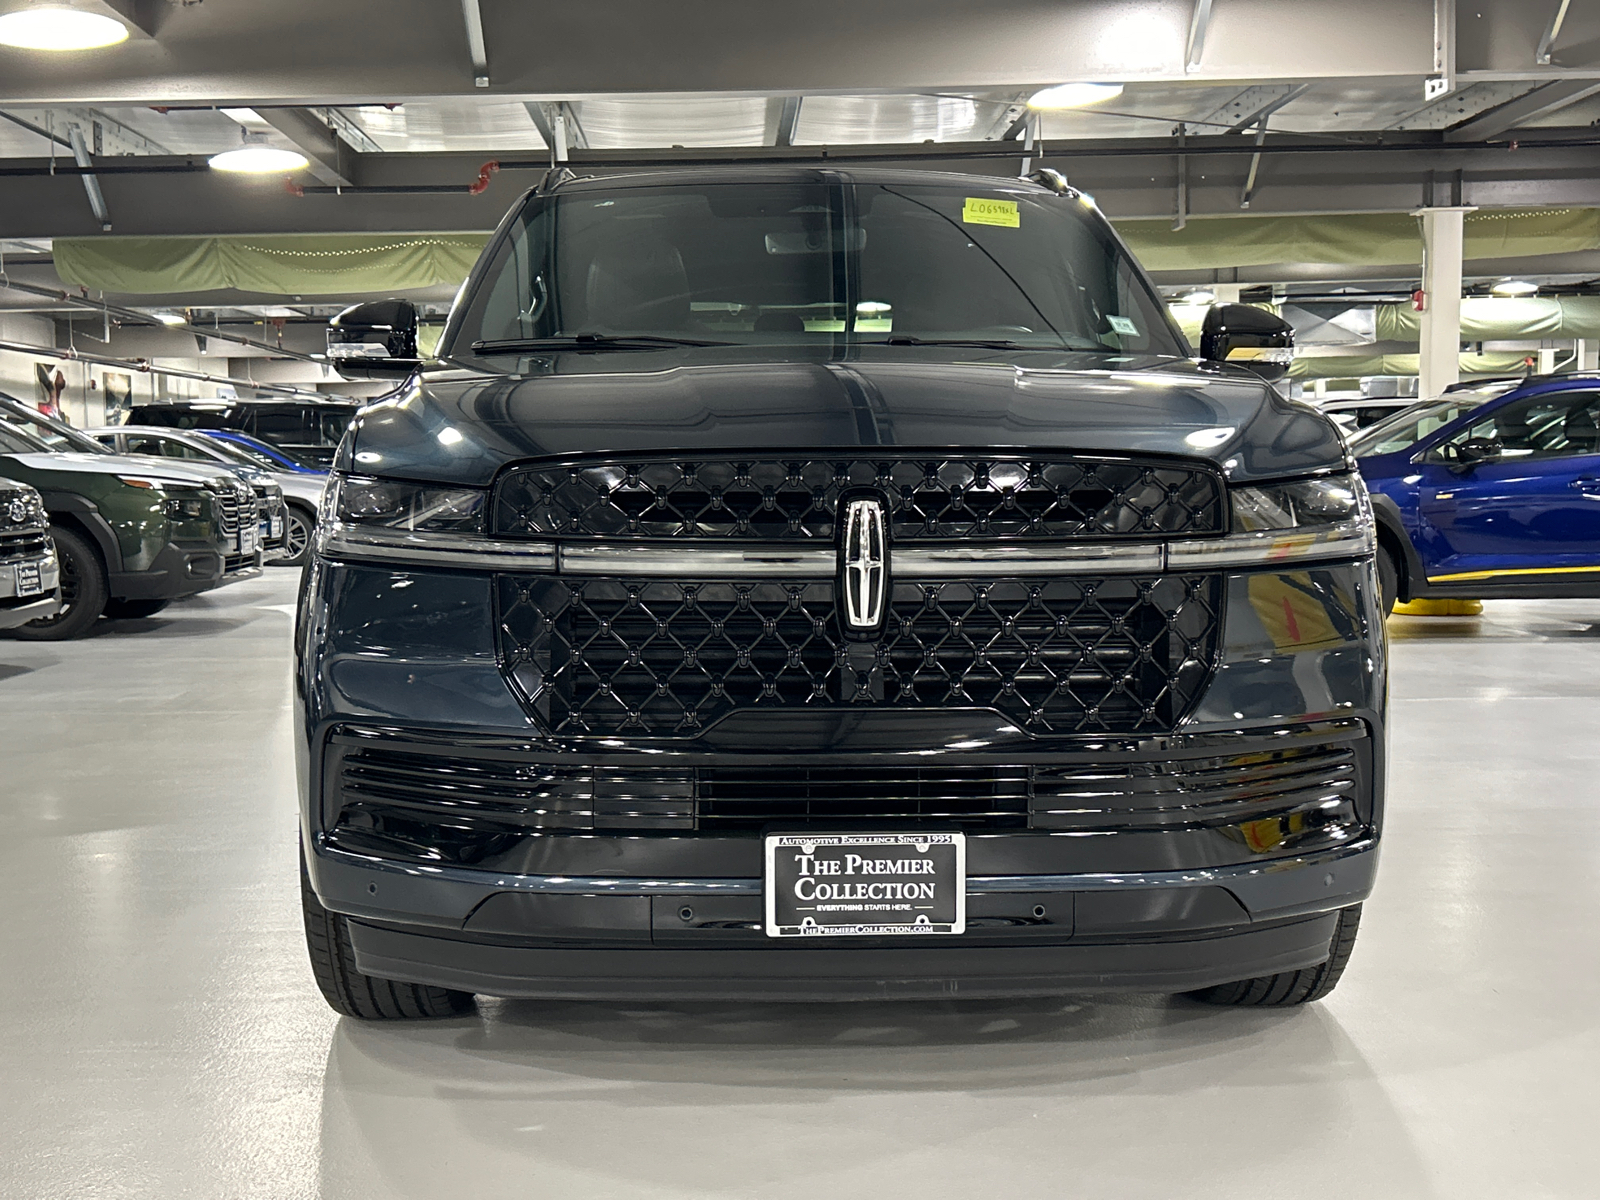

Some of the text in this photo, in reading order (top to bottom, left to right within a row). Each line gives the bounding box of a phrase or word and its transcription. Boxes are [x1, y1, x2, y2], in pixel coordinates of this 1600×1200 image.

[780, 834, 951, 845] AUTOMOTIVE EXCELLENCE SINCE 1995
[794, 854, 936, 876] THE PREMIER
[794, 877, 936, 901] COLLECTION
[816, 903, 913, 912] EVERYTHING STARTS HERE.
[798, 925, 934, 935] THEPREMIERCOLLECTION.COM
